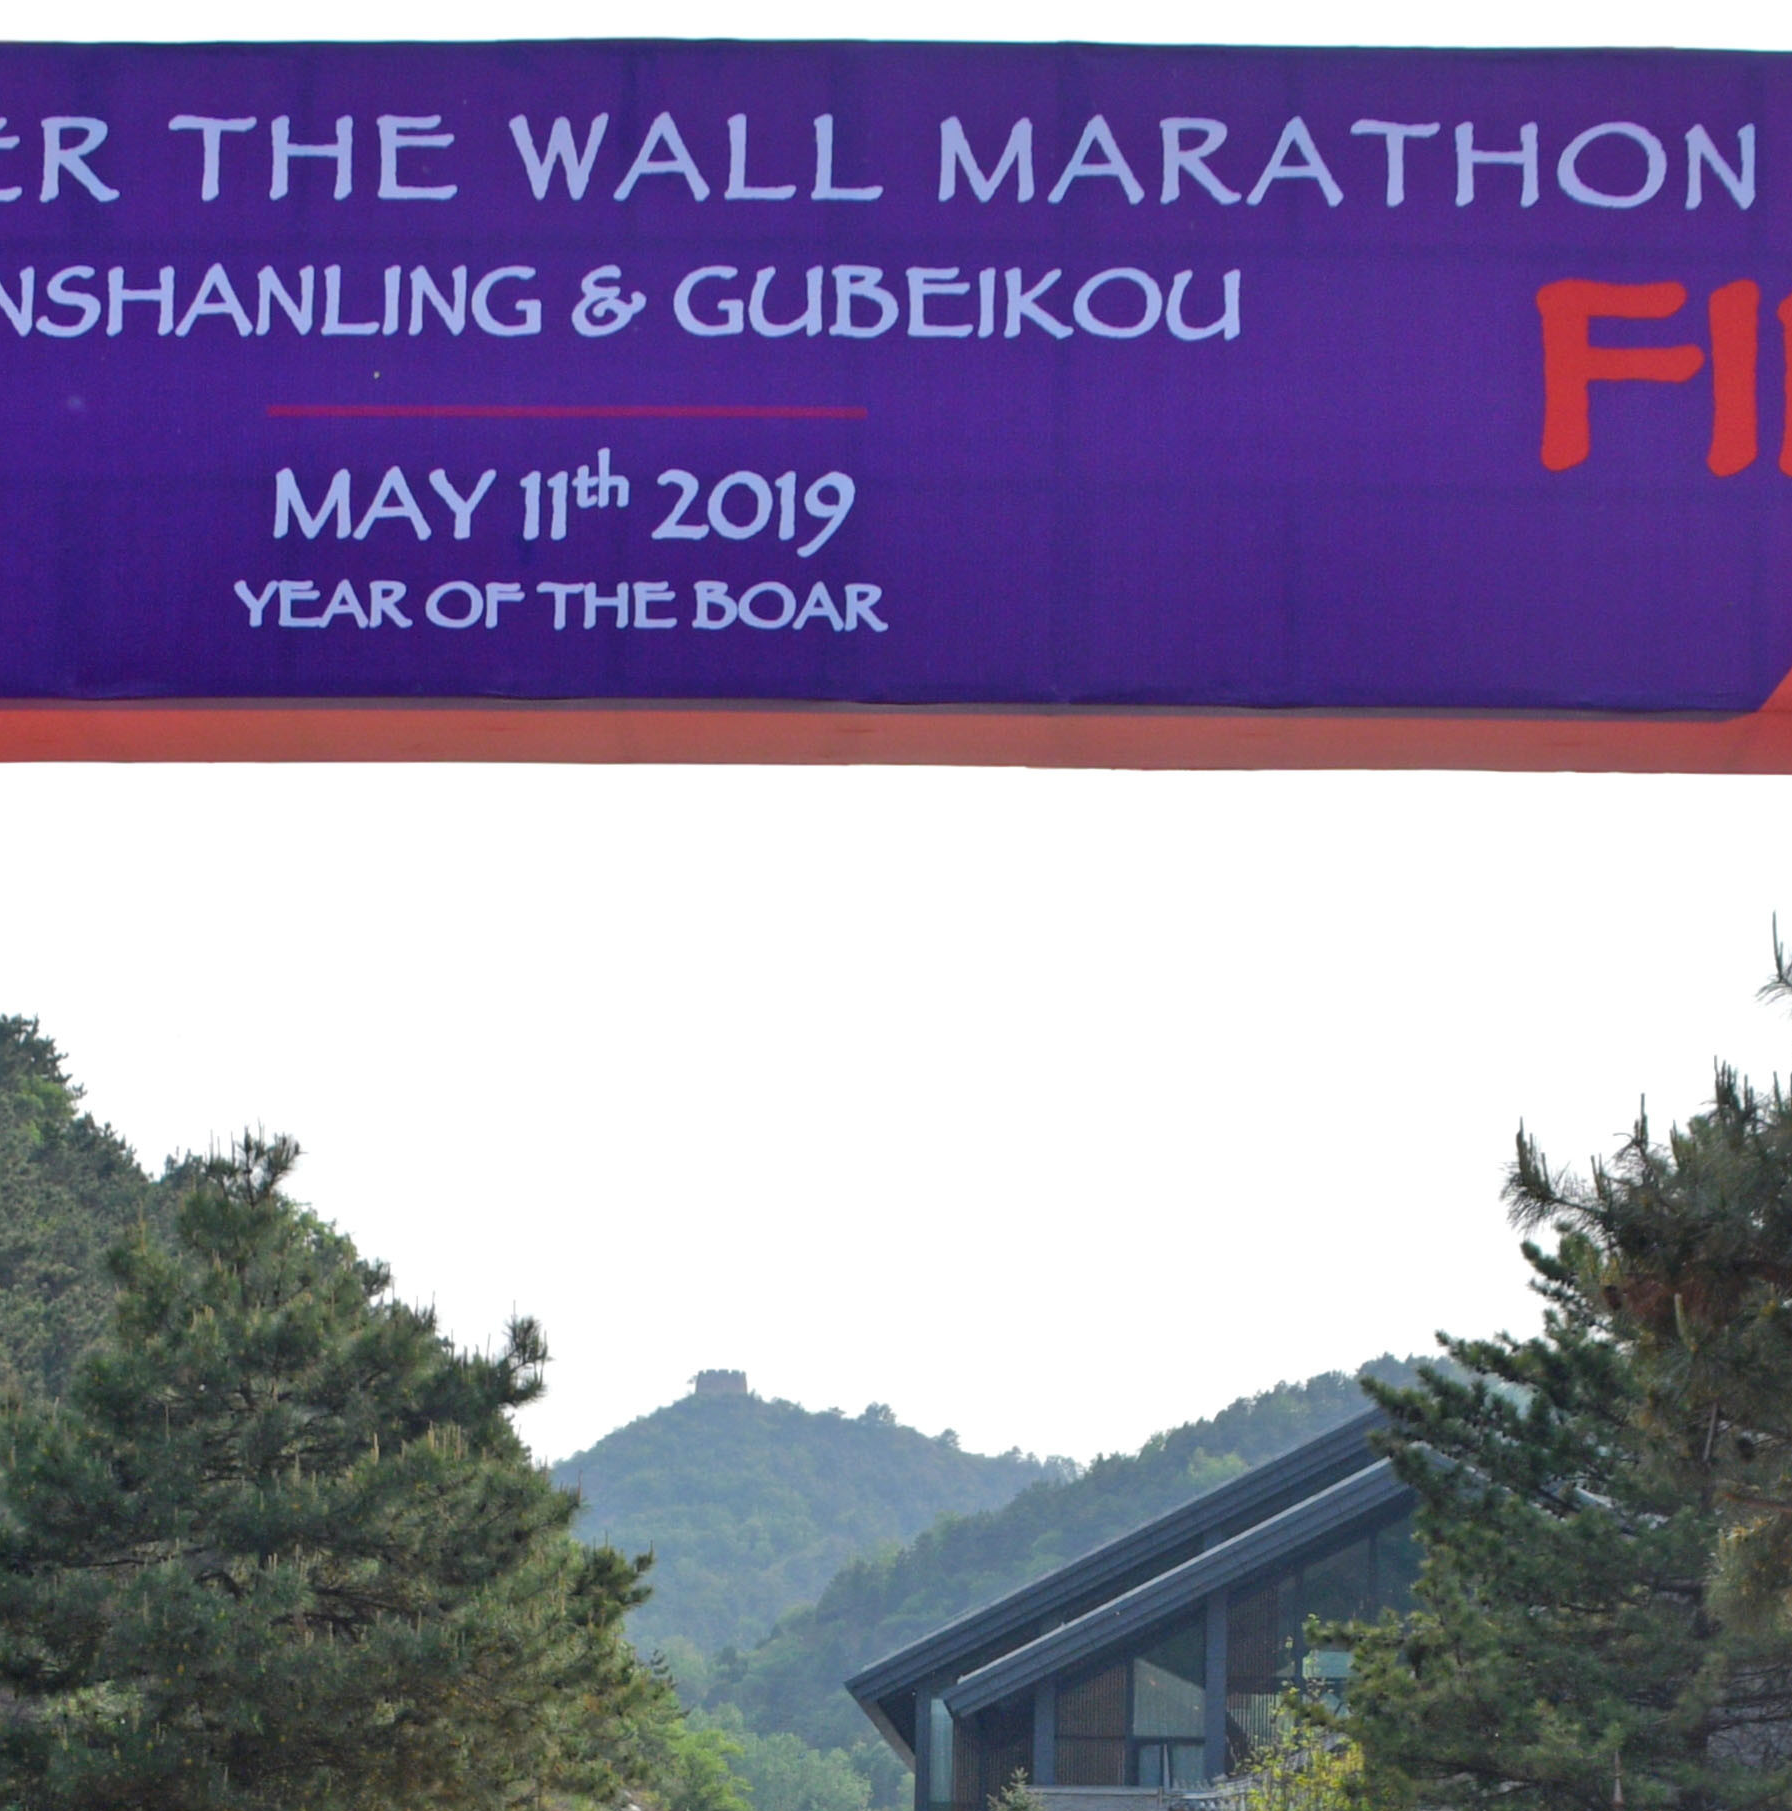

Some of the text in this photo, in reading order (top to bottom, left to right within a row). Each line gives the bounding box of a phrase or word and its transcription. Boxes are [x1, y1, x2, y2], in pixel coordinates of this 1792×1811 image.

[168, 113, 456, 206] THE
[509, 111, 884, 203] WALL
[938, 114, 1757, 210] MARATHON
[572, 264, 645, 337] &
[673, 265, 1241, 342] GUBEIKOU
[271, 448, 857, 558] MAY 11th 2019
[235, 578, 889, 635] YEAR OF THE BOAR
